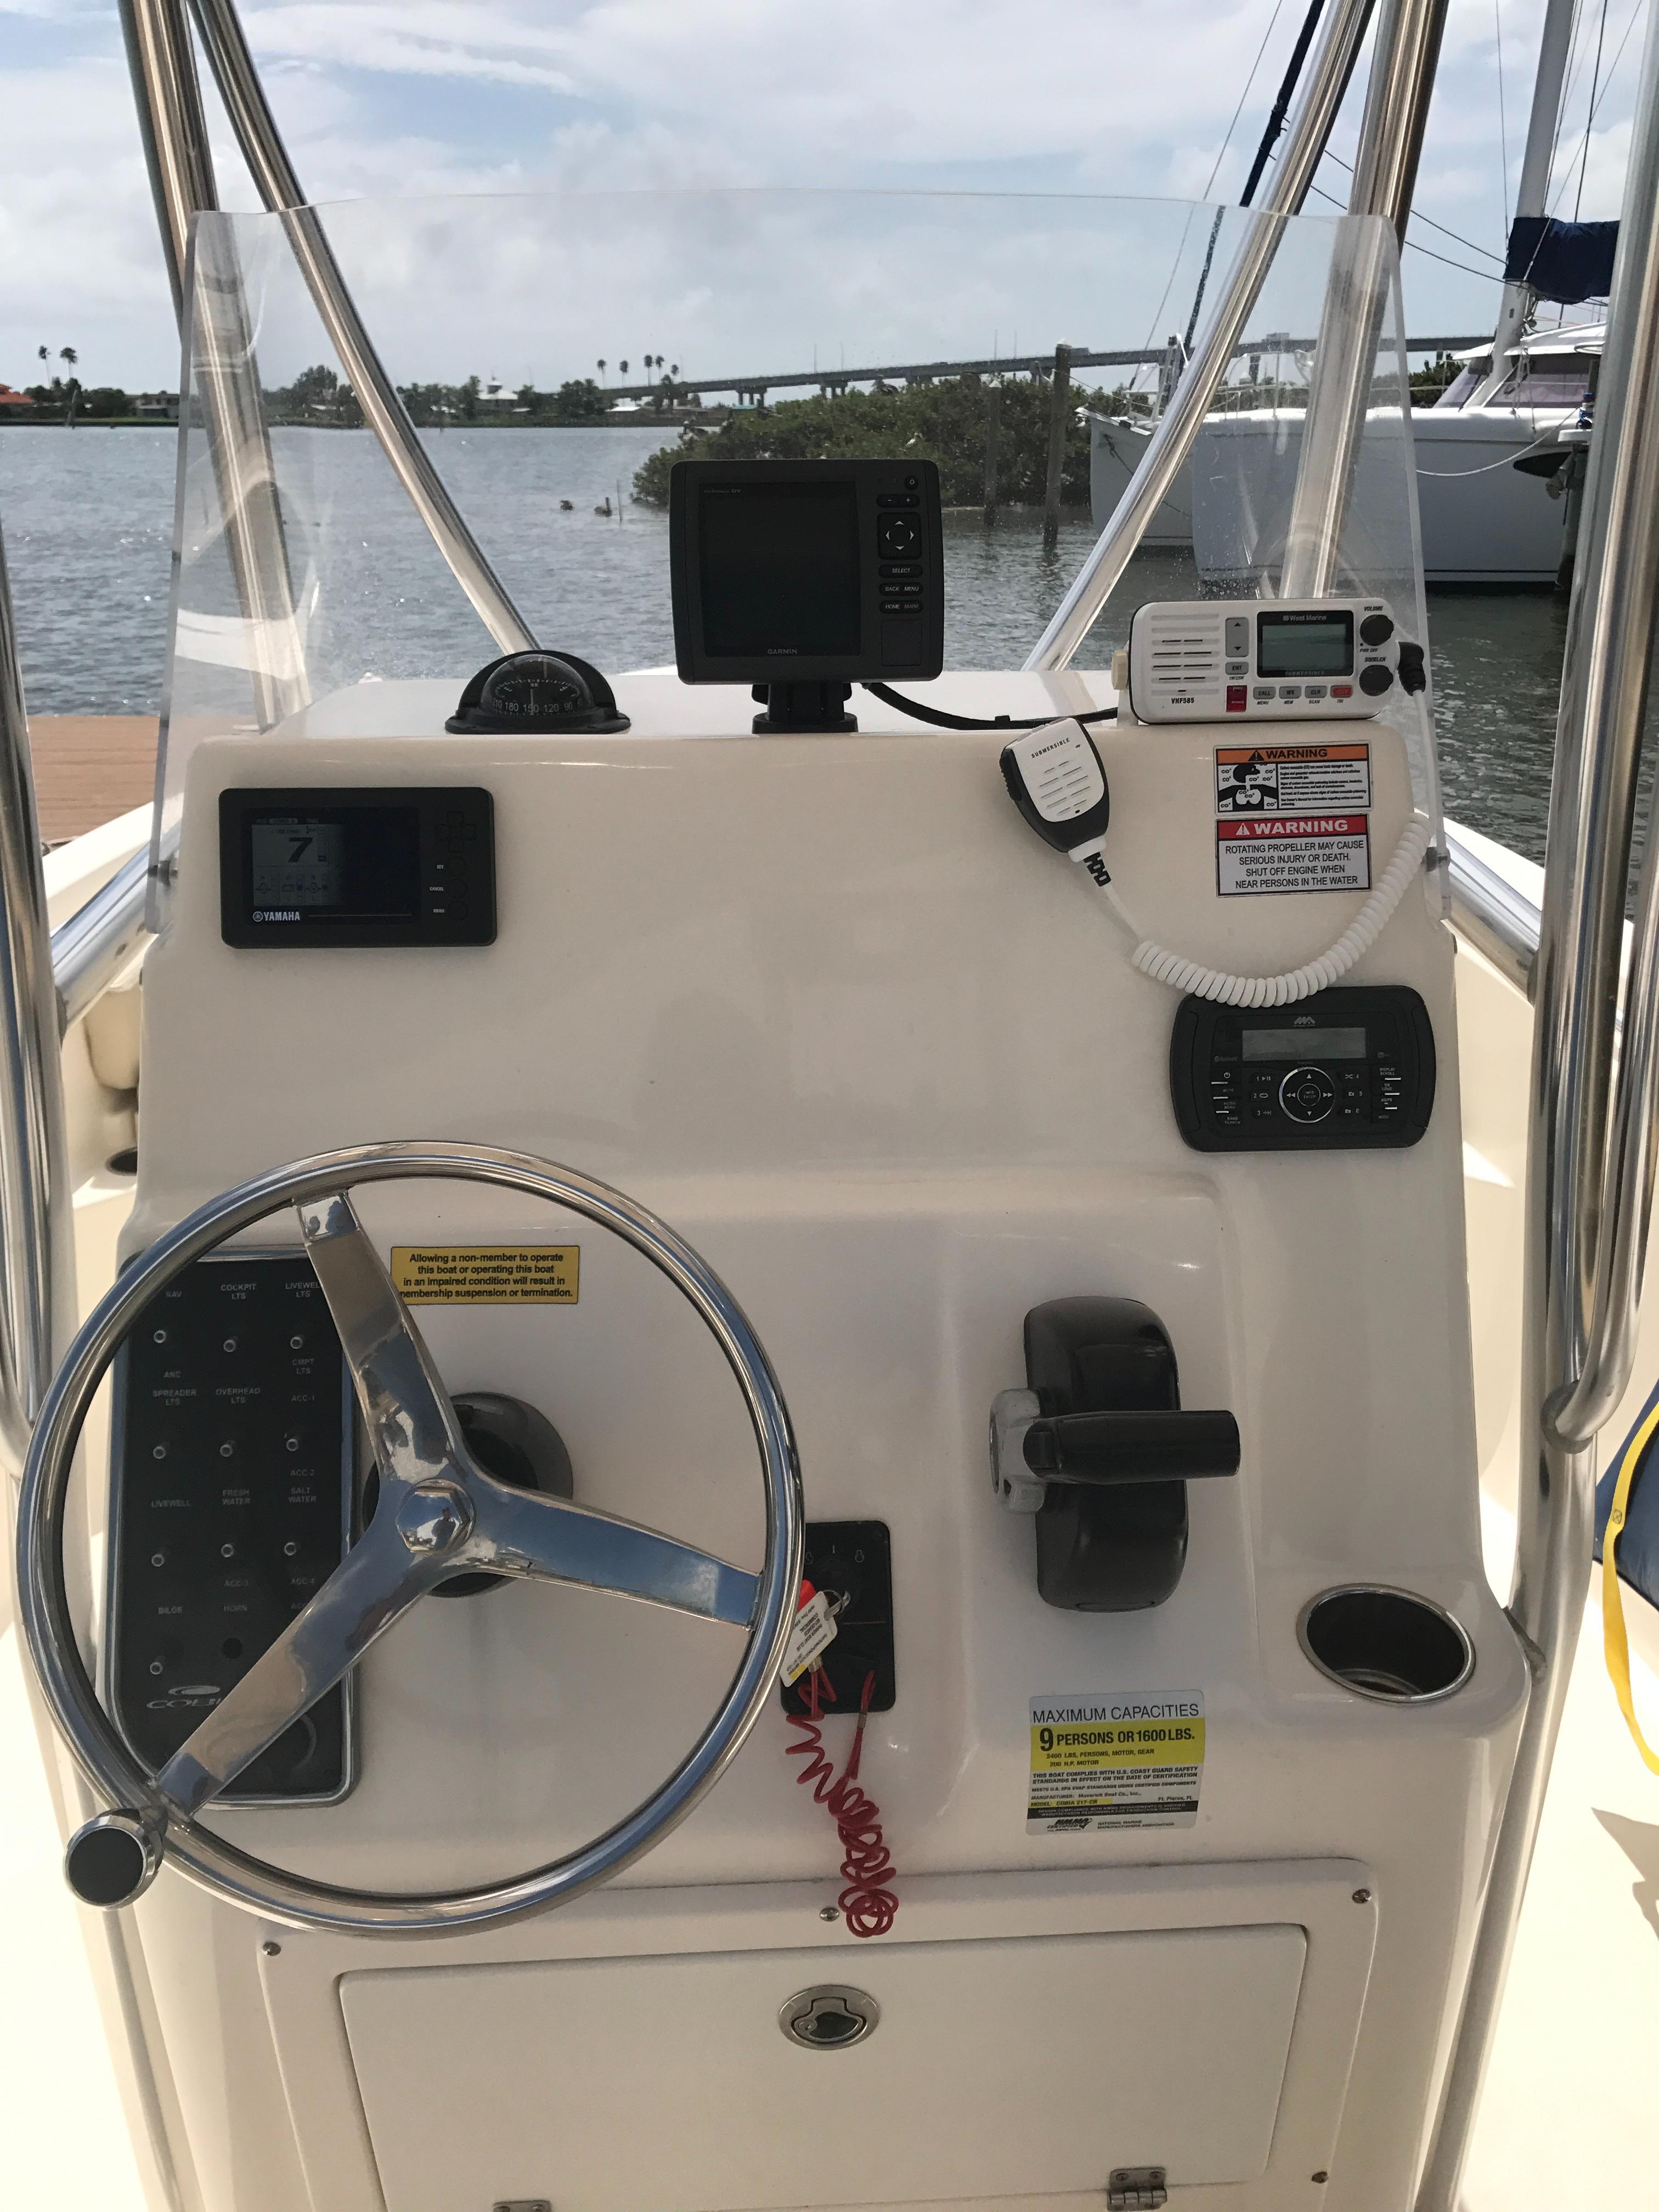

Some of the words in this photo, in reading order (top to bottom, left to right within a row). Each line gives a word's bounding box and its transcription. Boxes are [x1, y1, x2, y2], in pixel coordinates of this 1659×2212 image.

[505, 702, 519, 712] 180
[523, 704, 539, 713] 150
[543, 704, 559, 713] 120
[563, 702, 573, 711] 90
[1031, 737, 1070, 758] SUBMERSIBLE
[1266, 748, 1328, 759] WARNING
[1254, 820, 1348, 834] WARNING
[289, 837, 313, 863] 7
[1226, 844, 1266, 854] ROTATING
[1267, 842, 1316, 853] PROPELLER
[1318, 841, 1335, 850] MAY
[1336, 840, 1364, 849] CAUSE
[1239, 855, 1275, 865] SERIOUS
[1277, 854, 1305, 864] INJURY
[1308, 854, 1320, 862] OR
[1322, 853, 1351, 862] DEATH.
[1246, 867, 1267, 877] SHUT
[1269, 867, 1285, 876] OFF
[1289, 866, 1318, 875] ENGINE
[1321, 865, 1345, 873] WHEN
[1235, 880, 1259, 889] NEAR
[1260, 878, 1299, 888] PERSONS
[1301, 878, 1309, 886] IN
[1311, 877, 1327, 885] THE
[1329, 876, 1358, 885] WATER
[263, 911, 300, 922] YAMAHA
[409, 1254, 449, 1264] Allowing
[459, 1254, 517, 1262] non-member
[520, 1254, 528, 1262] to
[530, 1254, 563, 1263] operate
[417, 1265, 435, 1274] this
[437, 1265, 457, 1274] boat
[471, 1265, 514, 1275] operating
[516, 1265, 532, 1273] this
[534, 1264, 554, 1273] boat
[403, 1278, 411, 1286] in
[427, 1277, 466, 1287] impaired
[469, 1276, 510, 1285] condition
[512, 1276, 527, 1285] will
[530, 1276, 555, 1285] result
[557, 1276, 565, 1284] in
[221, 1284, 256, 1292] COCKPIT
[455, 1288, 506, 1299] suspension
[521, 1288, 573, 1297] termination.
[153, 1389, 197, 1397] SPREADER
[216, 1387, 261, 1396] OVERHEAD
[222, 1489, 250, 1497] FRESH
[151, 1499, 191, 1508] LIVEWELL
[158, 1606, 183, 1615] BILGE
[1033, 1707, 1107, 1723] MAXIMUM
[1111, 1703, 1199, 1720] CAPACITIES
[1040, 1728, 1053, 1752] 9
[1057, 1731, 1114, 1746] PERSONS
[1118, 1730, 1135, 1743] OR
[1137, 1729, 1166, 1742] 1600
[1169, 1728, 1195, 1740] LBS.
